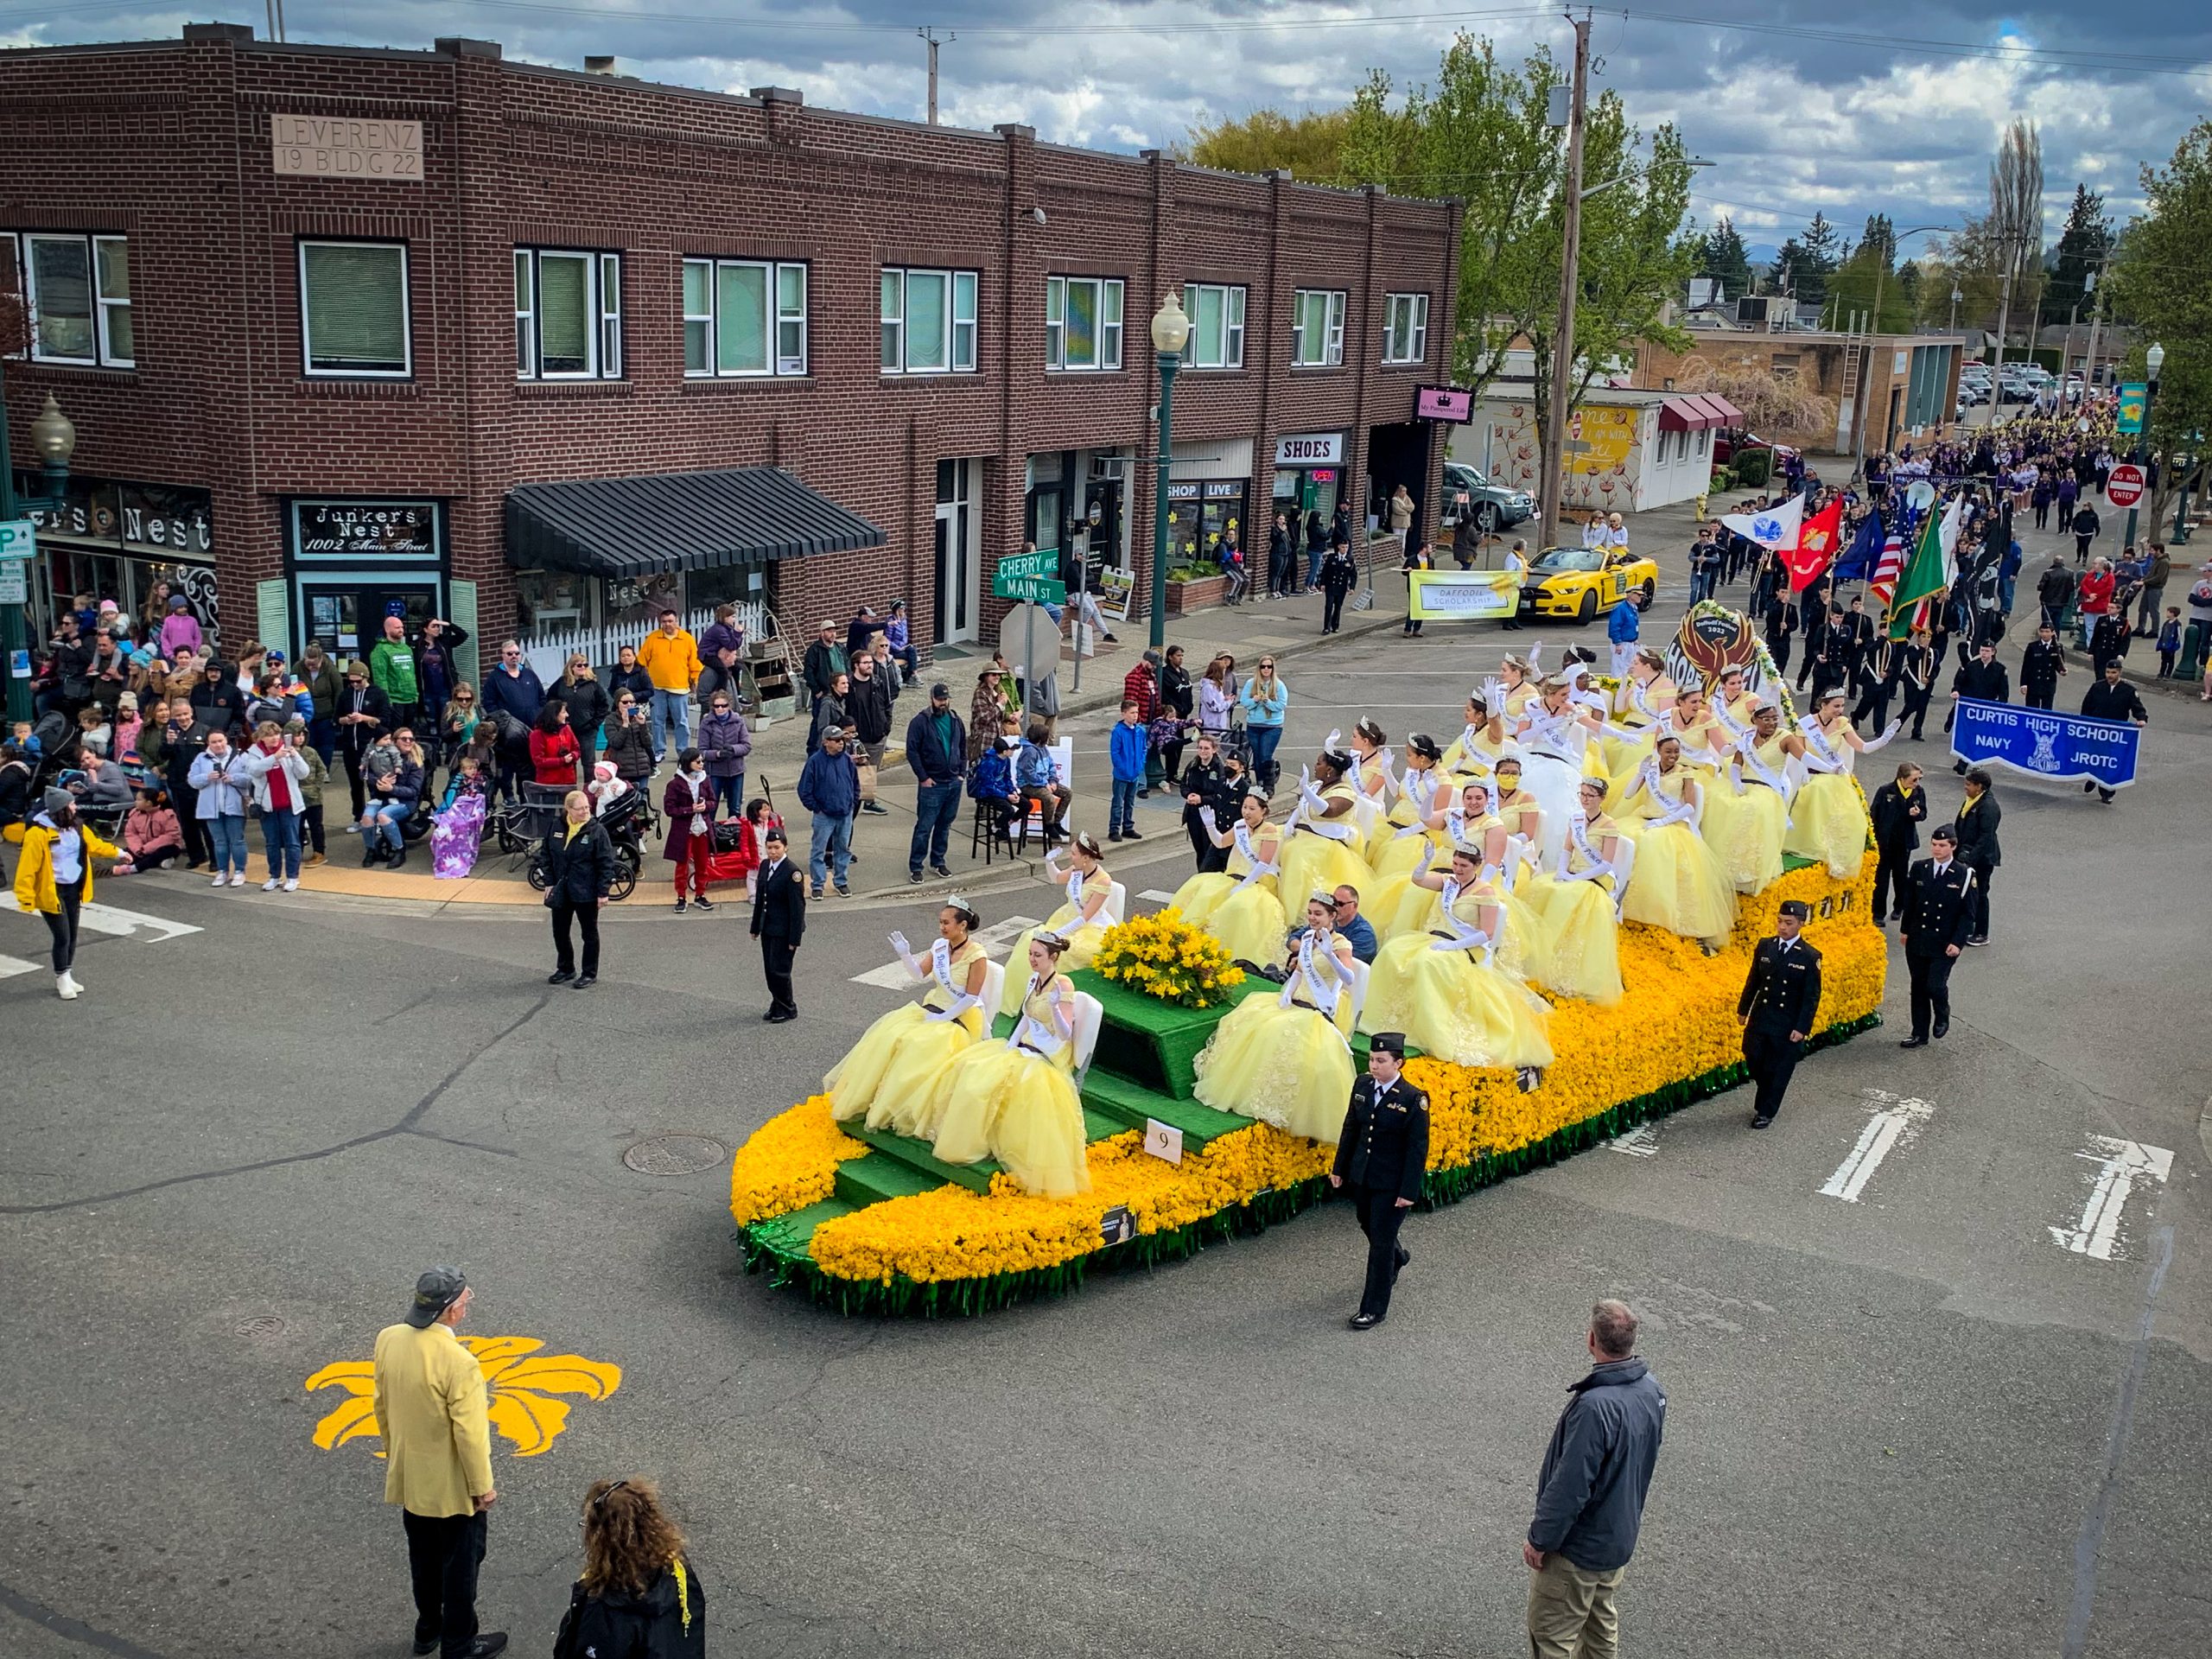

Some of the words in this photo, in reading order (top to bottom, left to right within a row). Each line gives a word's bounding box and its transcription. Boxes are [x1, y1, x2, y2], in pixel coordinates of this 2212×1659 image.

[277, 118, 416, 150] LEVERENZ
[282, 149, 302, 169] 19
[316, 150, 383, 174] BLDG
[393, 154, 416, 174] 22
[1284, 441, 1331, 457] SHOES
[1313, 470, 1333, 480] OPEN
[2126, 474, 2139, 482] NOT
[1210, 484, 1231, 496] LIVE
[2113, 491, 2133, 500] ENTER
[125, 507, 210, 550] Nest
[340, 523, 395, 537] Nest
[305, 538, 345, 551] 1002
[348, 539, 387, 551] Main
[391, 538, 429, 551] Street
[1000, 555, 1042, 578] CHERRY
[1044, 557, 1058, 570] AVE
[609, 581, 650, 601] Nest
[1007, 579, 1038, 598] MAIN
[1040, 588, 1052, 600] ST
[1966, 707, 2018, 727] CURTIS
[2025, 716, 2060, 734] HIGH
[2067, 724, 2128, 745] SCHOOL
[1975, 734, 2012, 750] NAVY
[2070, 752, 2118, 769] JROTC
[1160, 1132, 1169, 1148] 9
